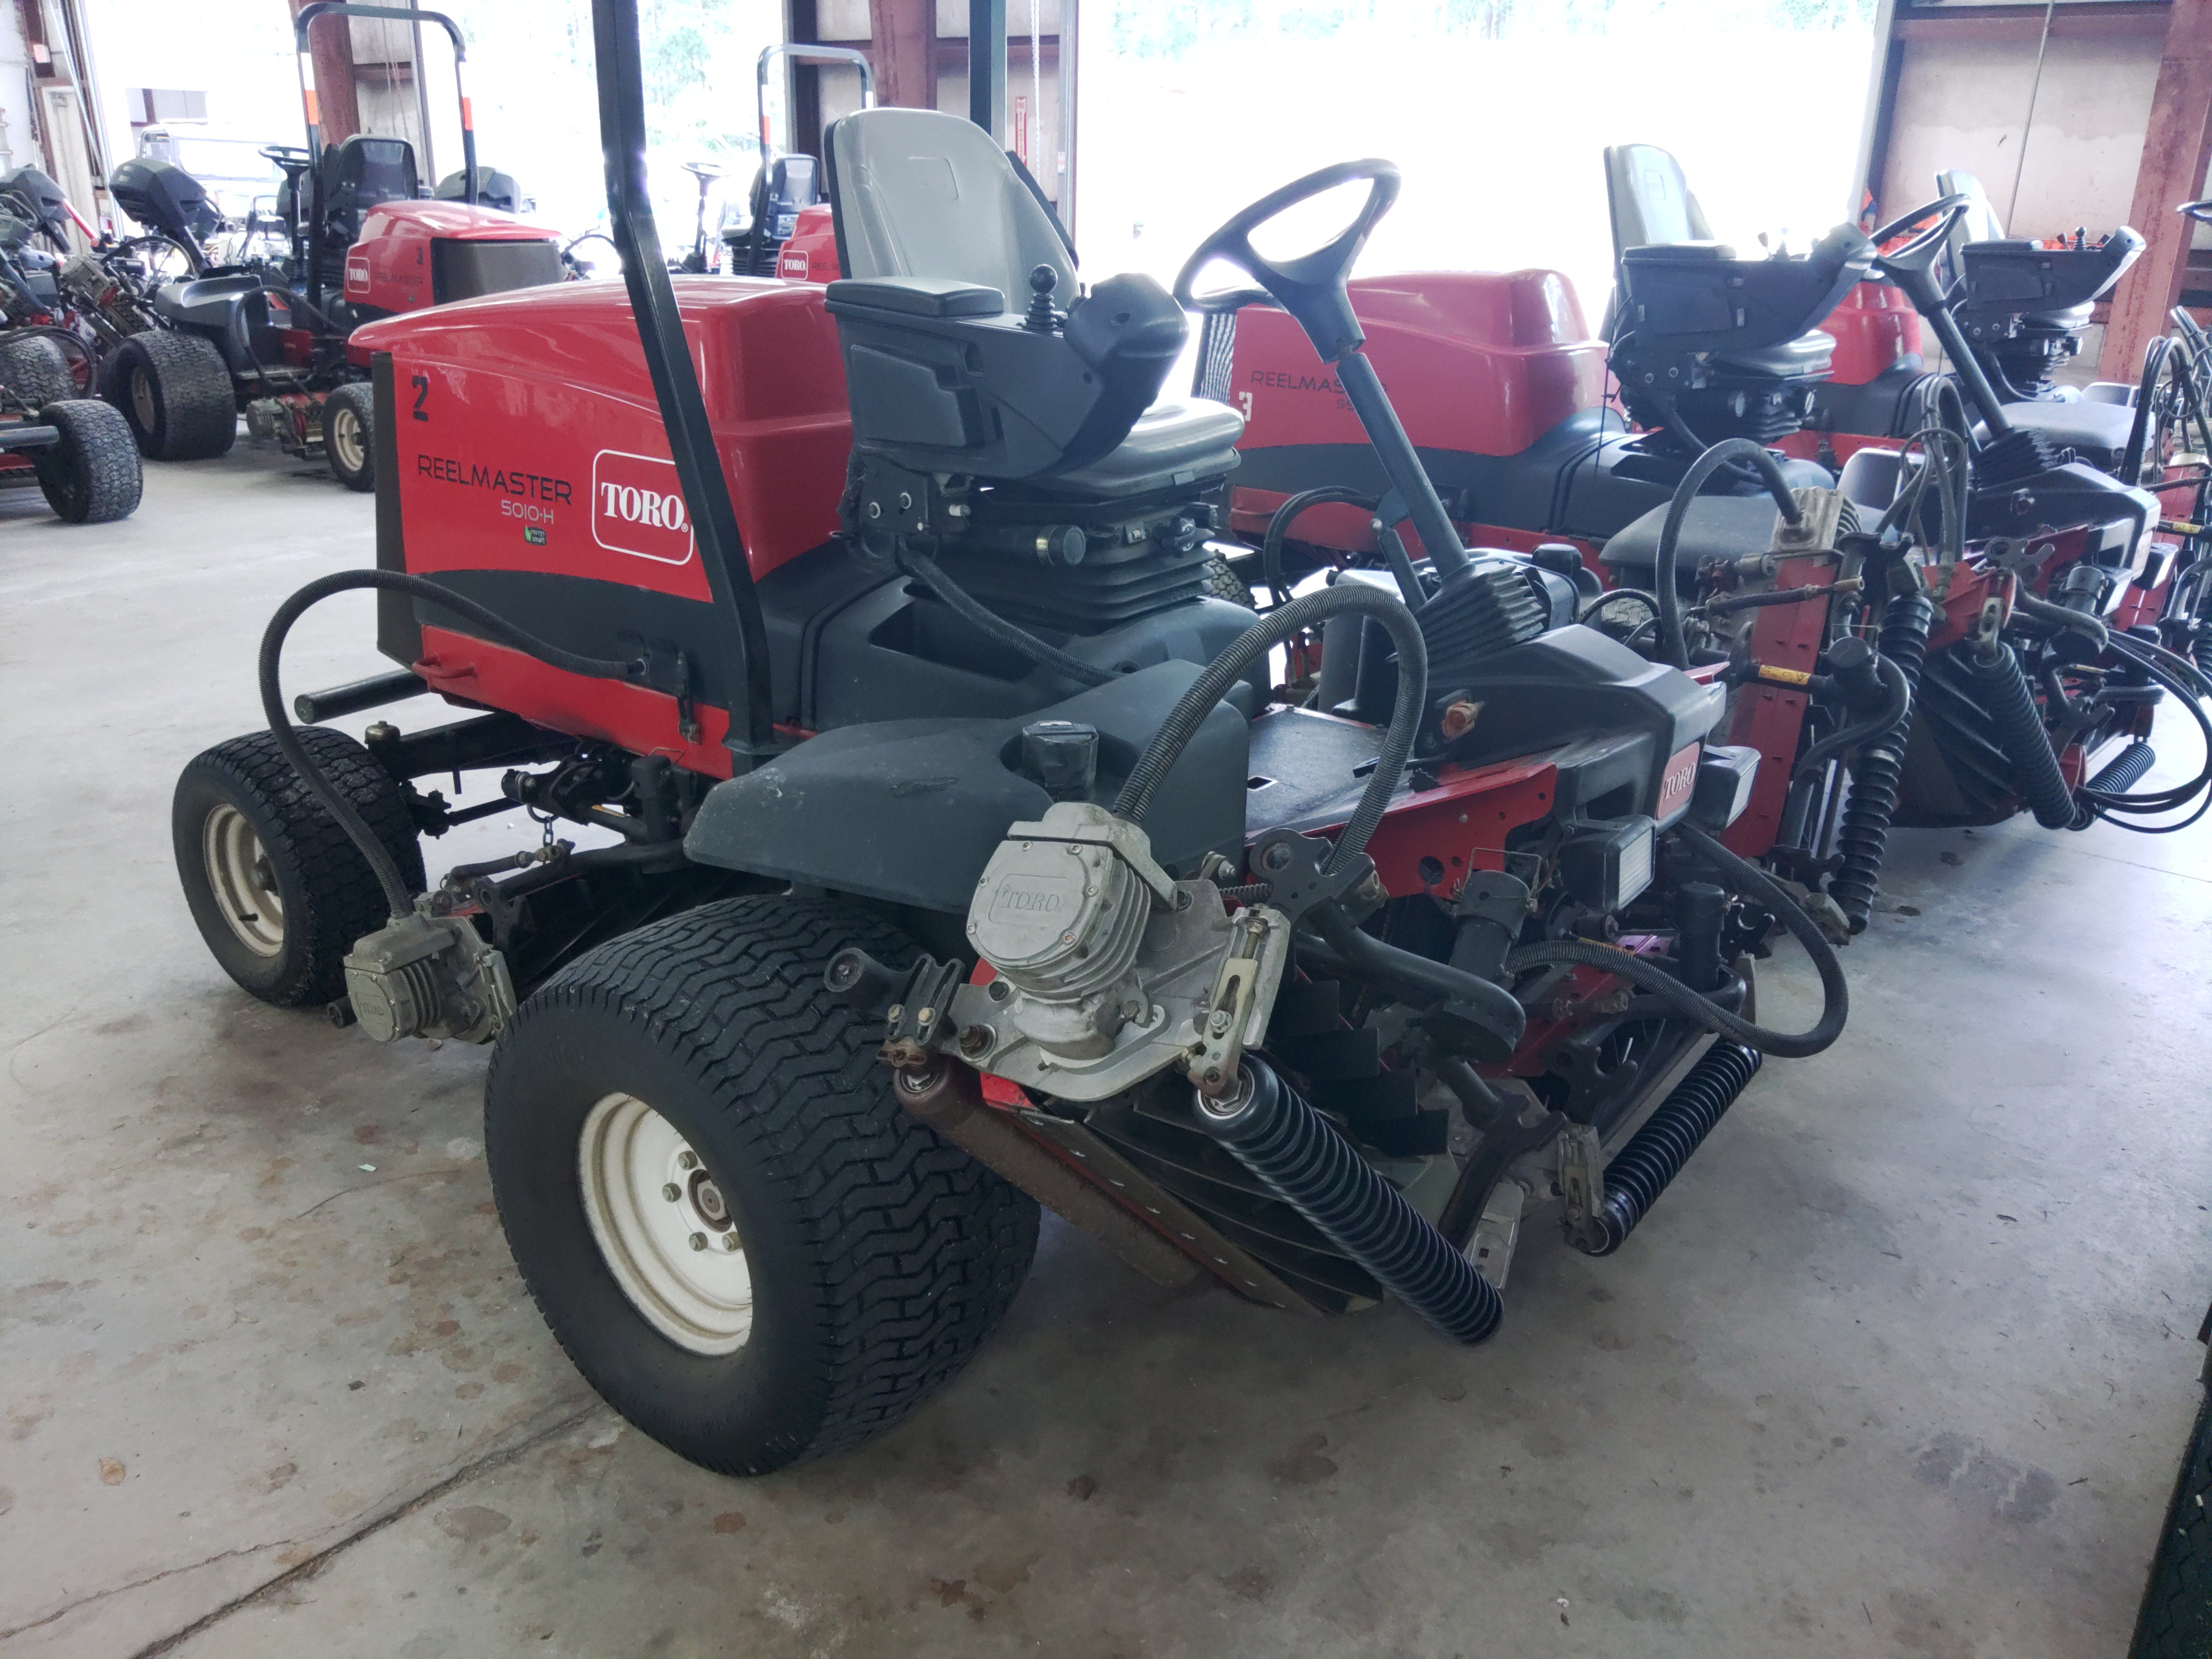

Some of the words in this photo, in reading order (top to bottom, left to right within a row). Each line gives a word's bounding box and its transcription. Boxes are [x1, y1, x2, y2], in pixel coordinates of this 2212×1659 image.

[349, 268, 368, 282] TORO
[784, 259, 806, 271] TORO
[412, 375, 428, 422] 2
[1239, 391, 1252, 422] 3
[418, 454, 572, 505] REELMASTER
[601, 482, 685, 530] TORO
[1664, 762, 1695, 801] TORO
[1001, 890, 1060, 912] TORO
